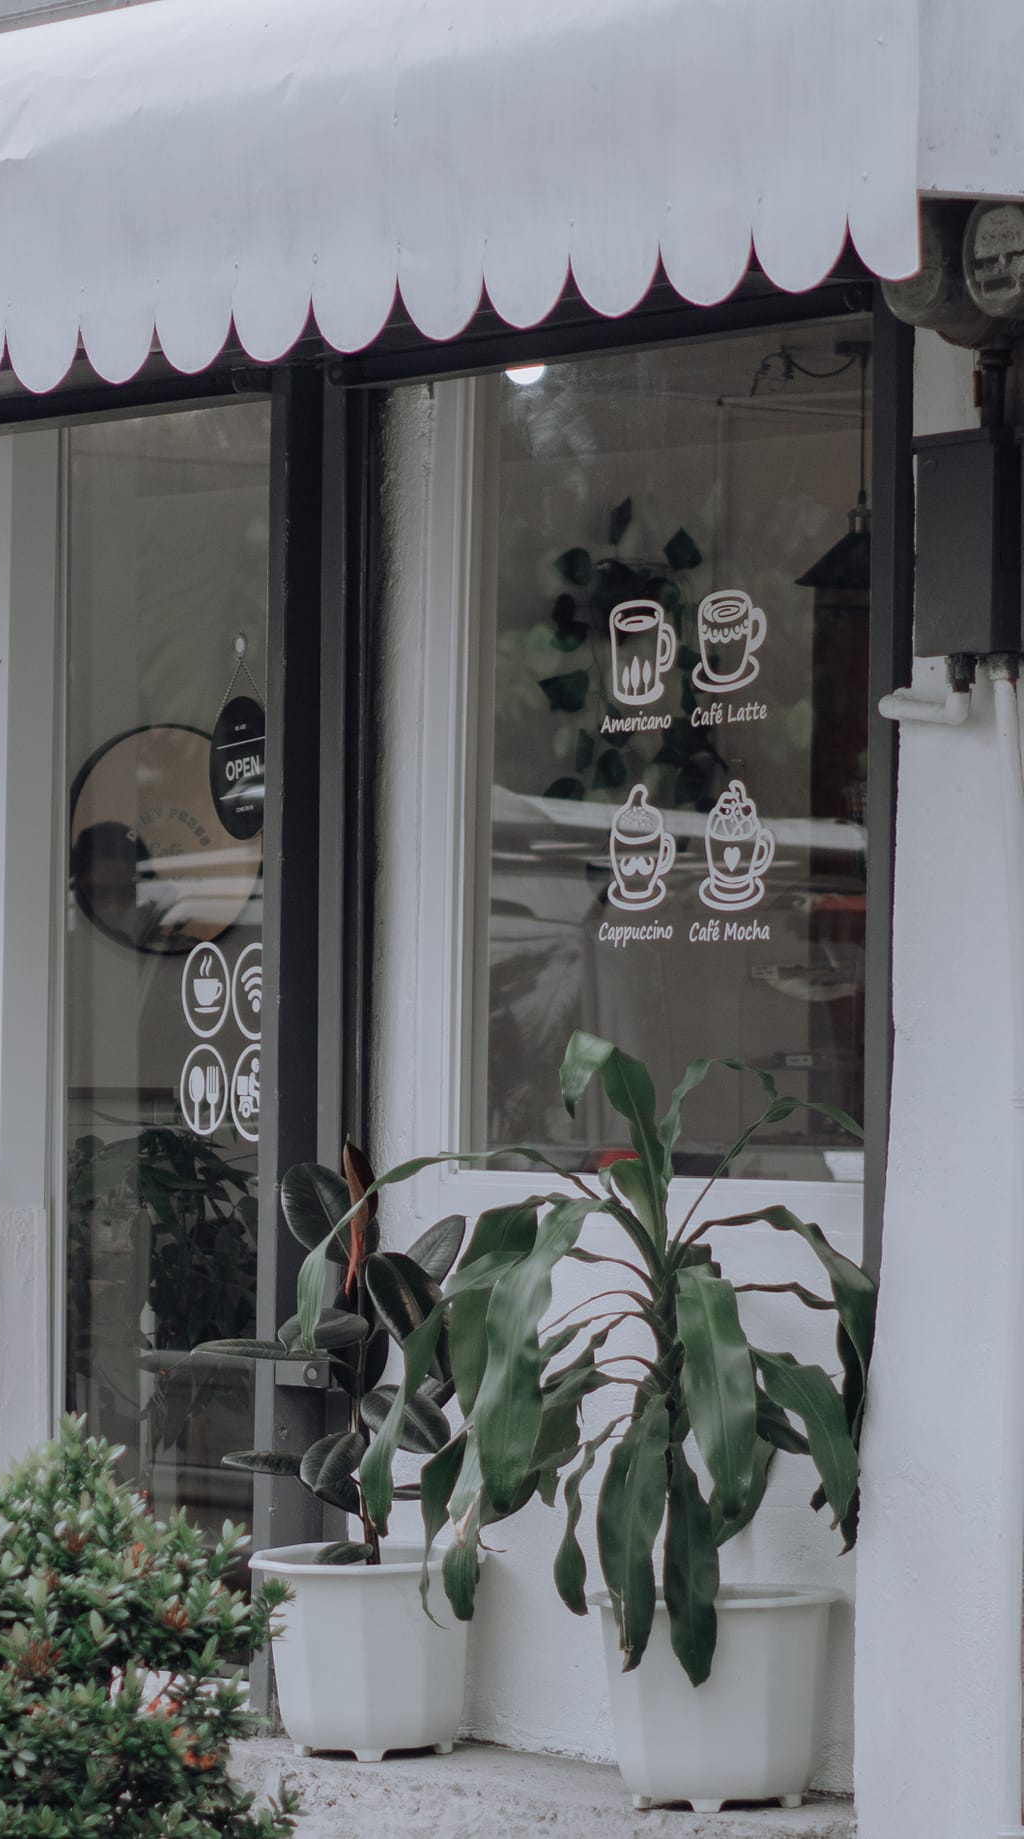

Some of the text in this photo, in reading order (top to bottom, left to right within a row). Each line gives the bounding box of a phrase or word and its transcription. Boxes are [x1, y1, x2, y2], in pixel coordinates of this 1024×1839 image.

[600, 710, 671, 734] Americano
[690, 702, 768, 728] Café Latte
[225, 754, 260, 782] OPEN
[598, 919, 674, 947] Cappuccino
[688, 920, 771, 943] Café Mocha
